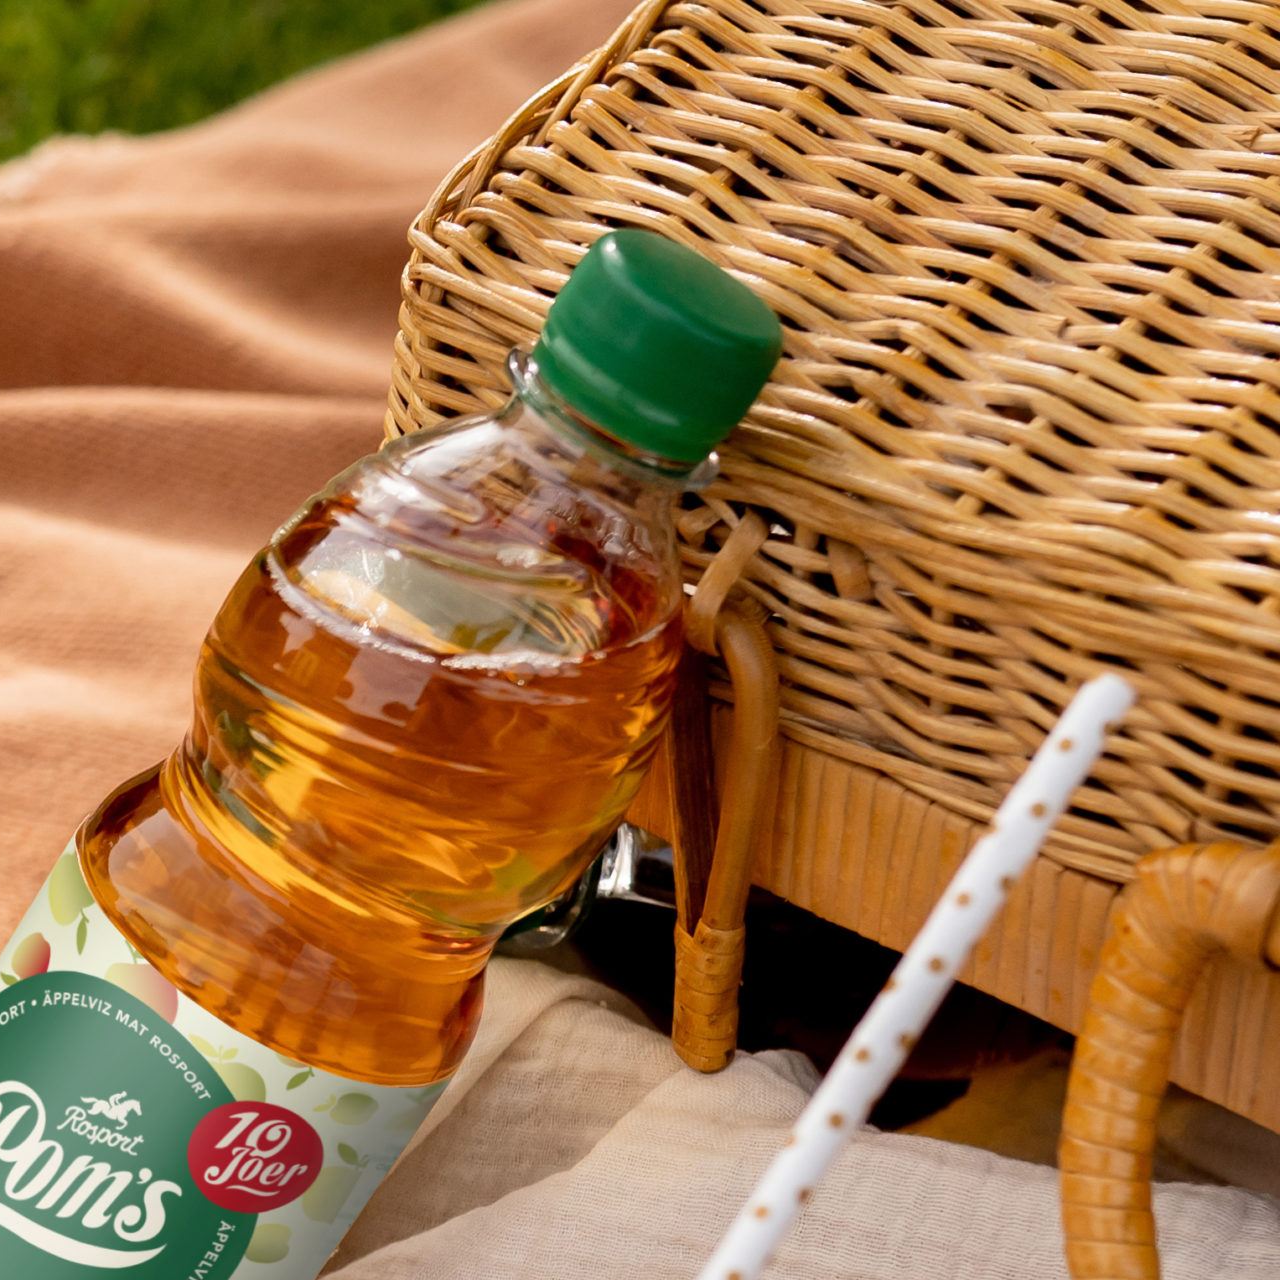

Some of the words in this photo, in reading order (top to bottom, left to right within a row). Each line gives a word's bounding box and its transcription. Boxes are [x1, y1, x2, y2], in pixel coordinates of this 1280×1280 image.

[42, 989, 113, 1017] ÄPPELVIZ
[115, 1009, 149, 1037] MAT
[149, 1034, 211, 1101] ROSPORT
[56, 1105, 144, 1157] Rosport
[213, 1111, 292, 1159] 10
[203, 1146, 309, 1187] Joer
